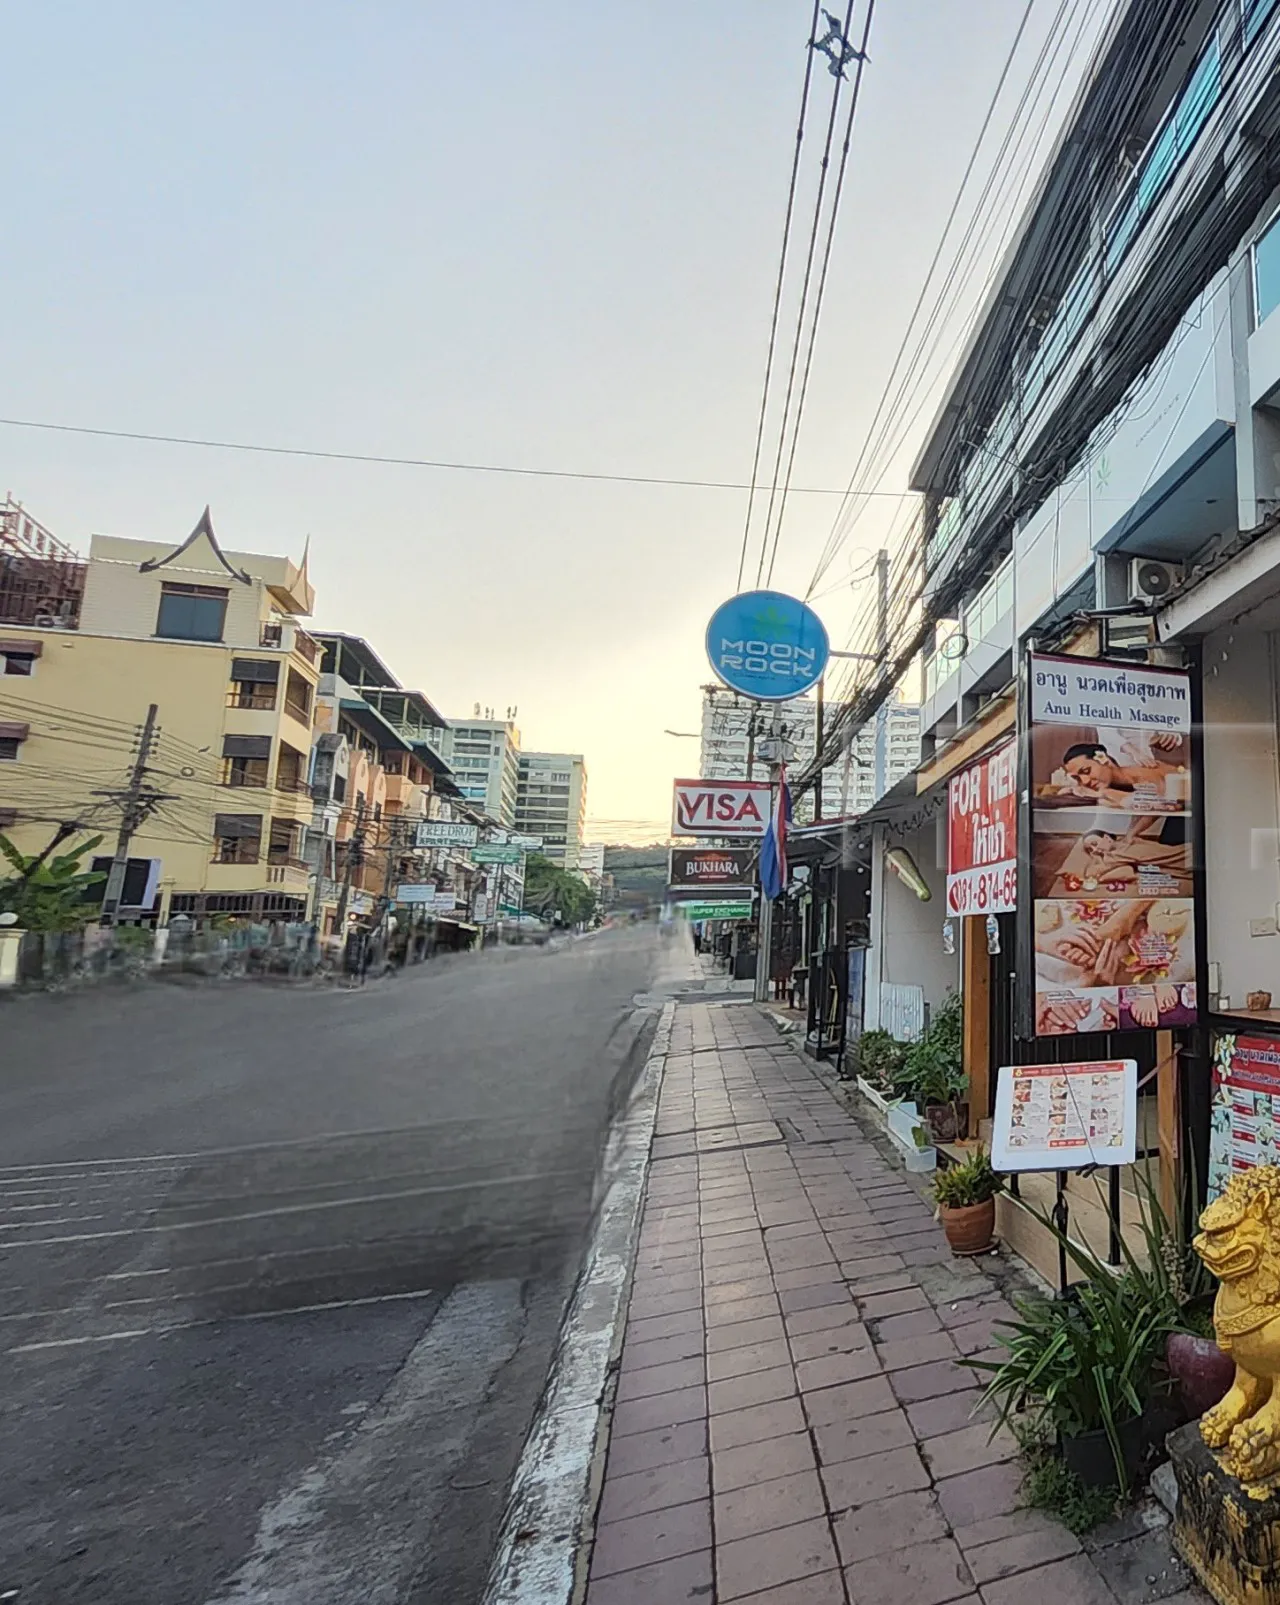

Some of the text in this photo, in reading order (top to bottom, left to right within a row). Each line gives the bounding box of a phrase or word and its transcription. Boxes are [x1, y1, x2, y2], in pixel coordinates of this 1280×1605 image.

[721, 638, 816, 660] MOON
[720, 654, 814, 677] ROCK
[1036, 672, 1186, 704] อานู นวดเพื่อสุขภาพ
[1044, 701, 1181, 728] Anu Health Massage
[951, 746, 1017, 819] FOR REN
[678, 792, 763, 823] VISA
[971, 808, 1006, 866] ให้เช่า
[685, 861, 740, 876] BUKHARA
